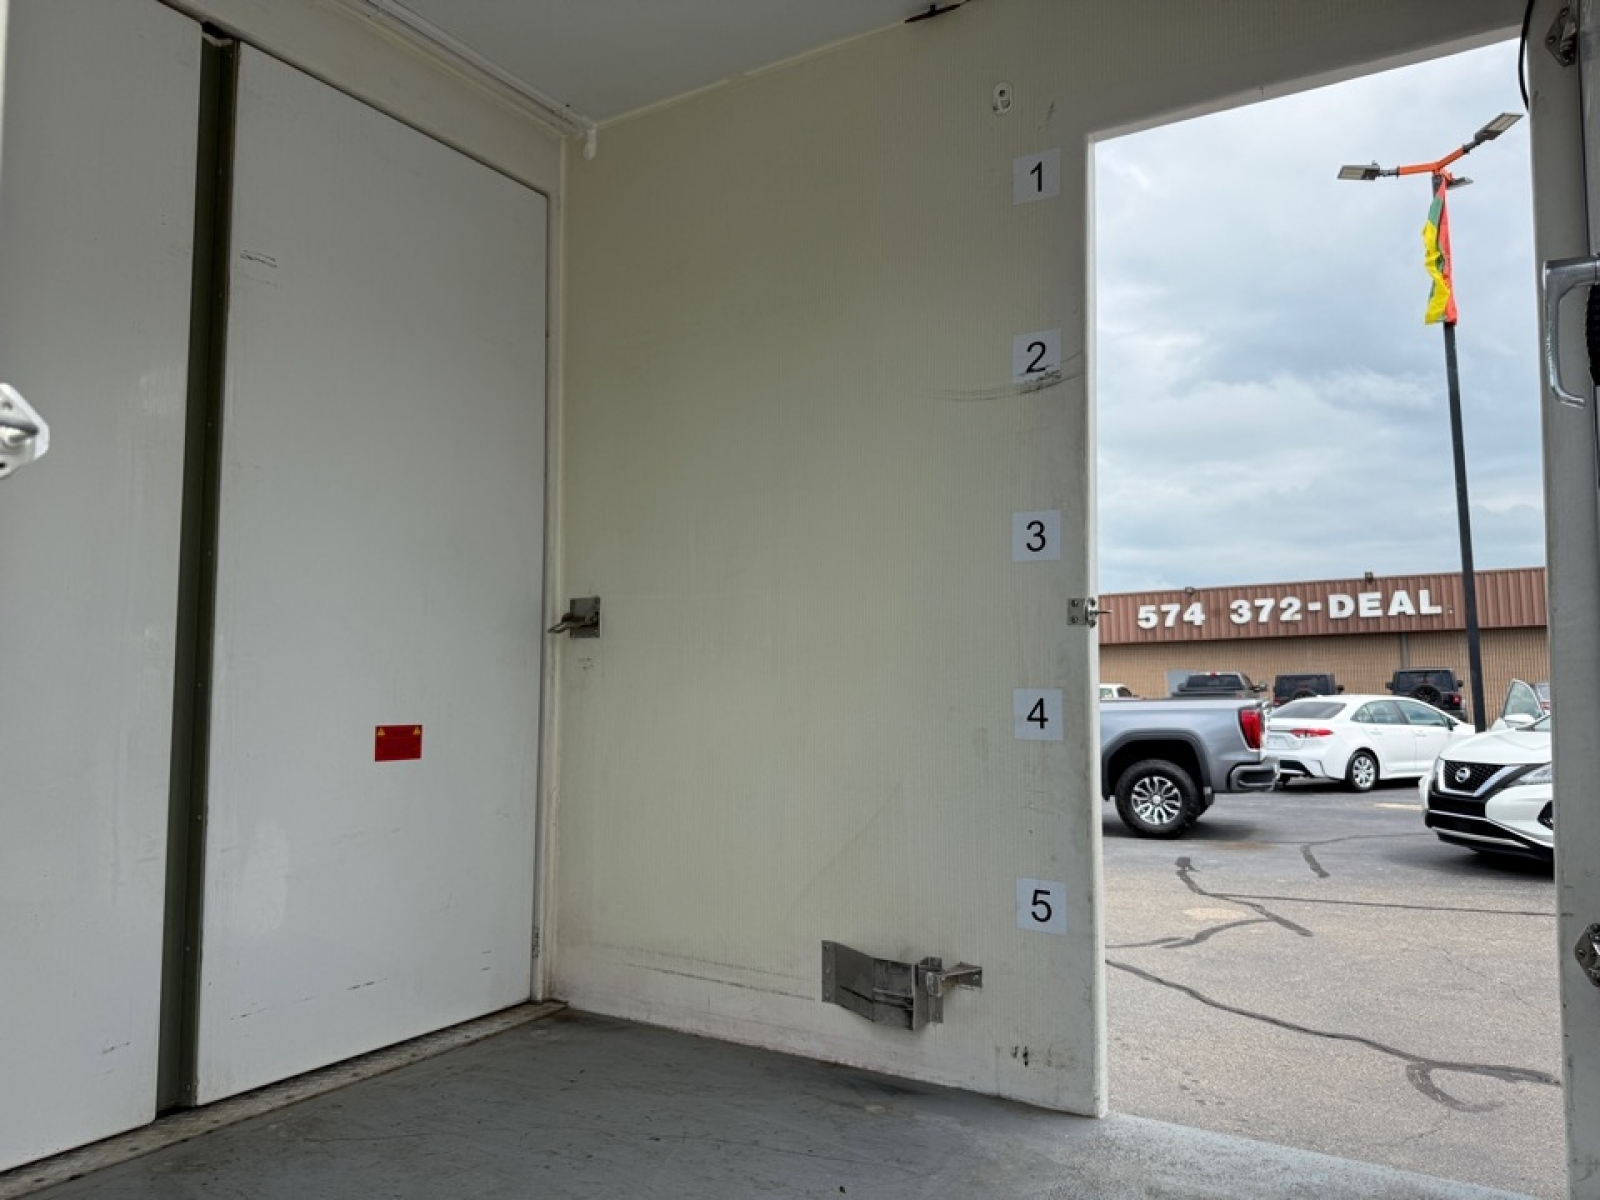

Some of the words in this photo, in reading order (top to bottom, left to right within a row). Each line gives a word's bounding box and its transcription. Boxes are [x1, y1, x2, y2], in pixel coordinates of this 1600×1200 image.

[1029, 162, 1044, 193] 1
[1026, 341, 1048, 373] 2
[1025, 520, 1048, 553] 3
[1136, 601, 1206, 630] 574
[1229, 588, 1444, 624] 372-DEAL
[1026, 698, 1049, 730] 4
[1030, 889, 1053, 923] 5
